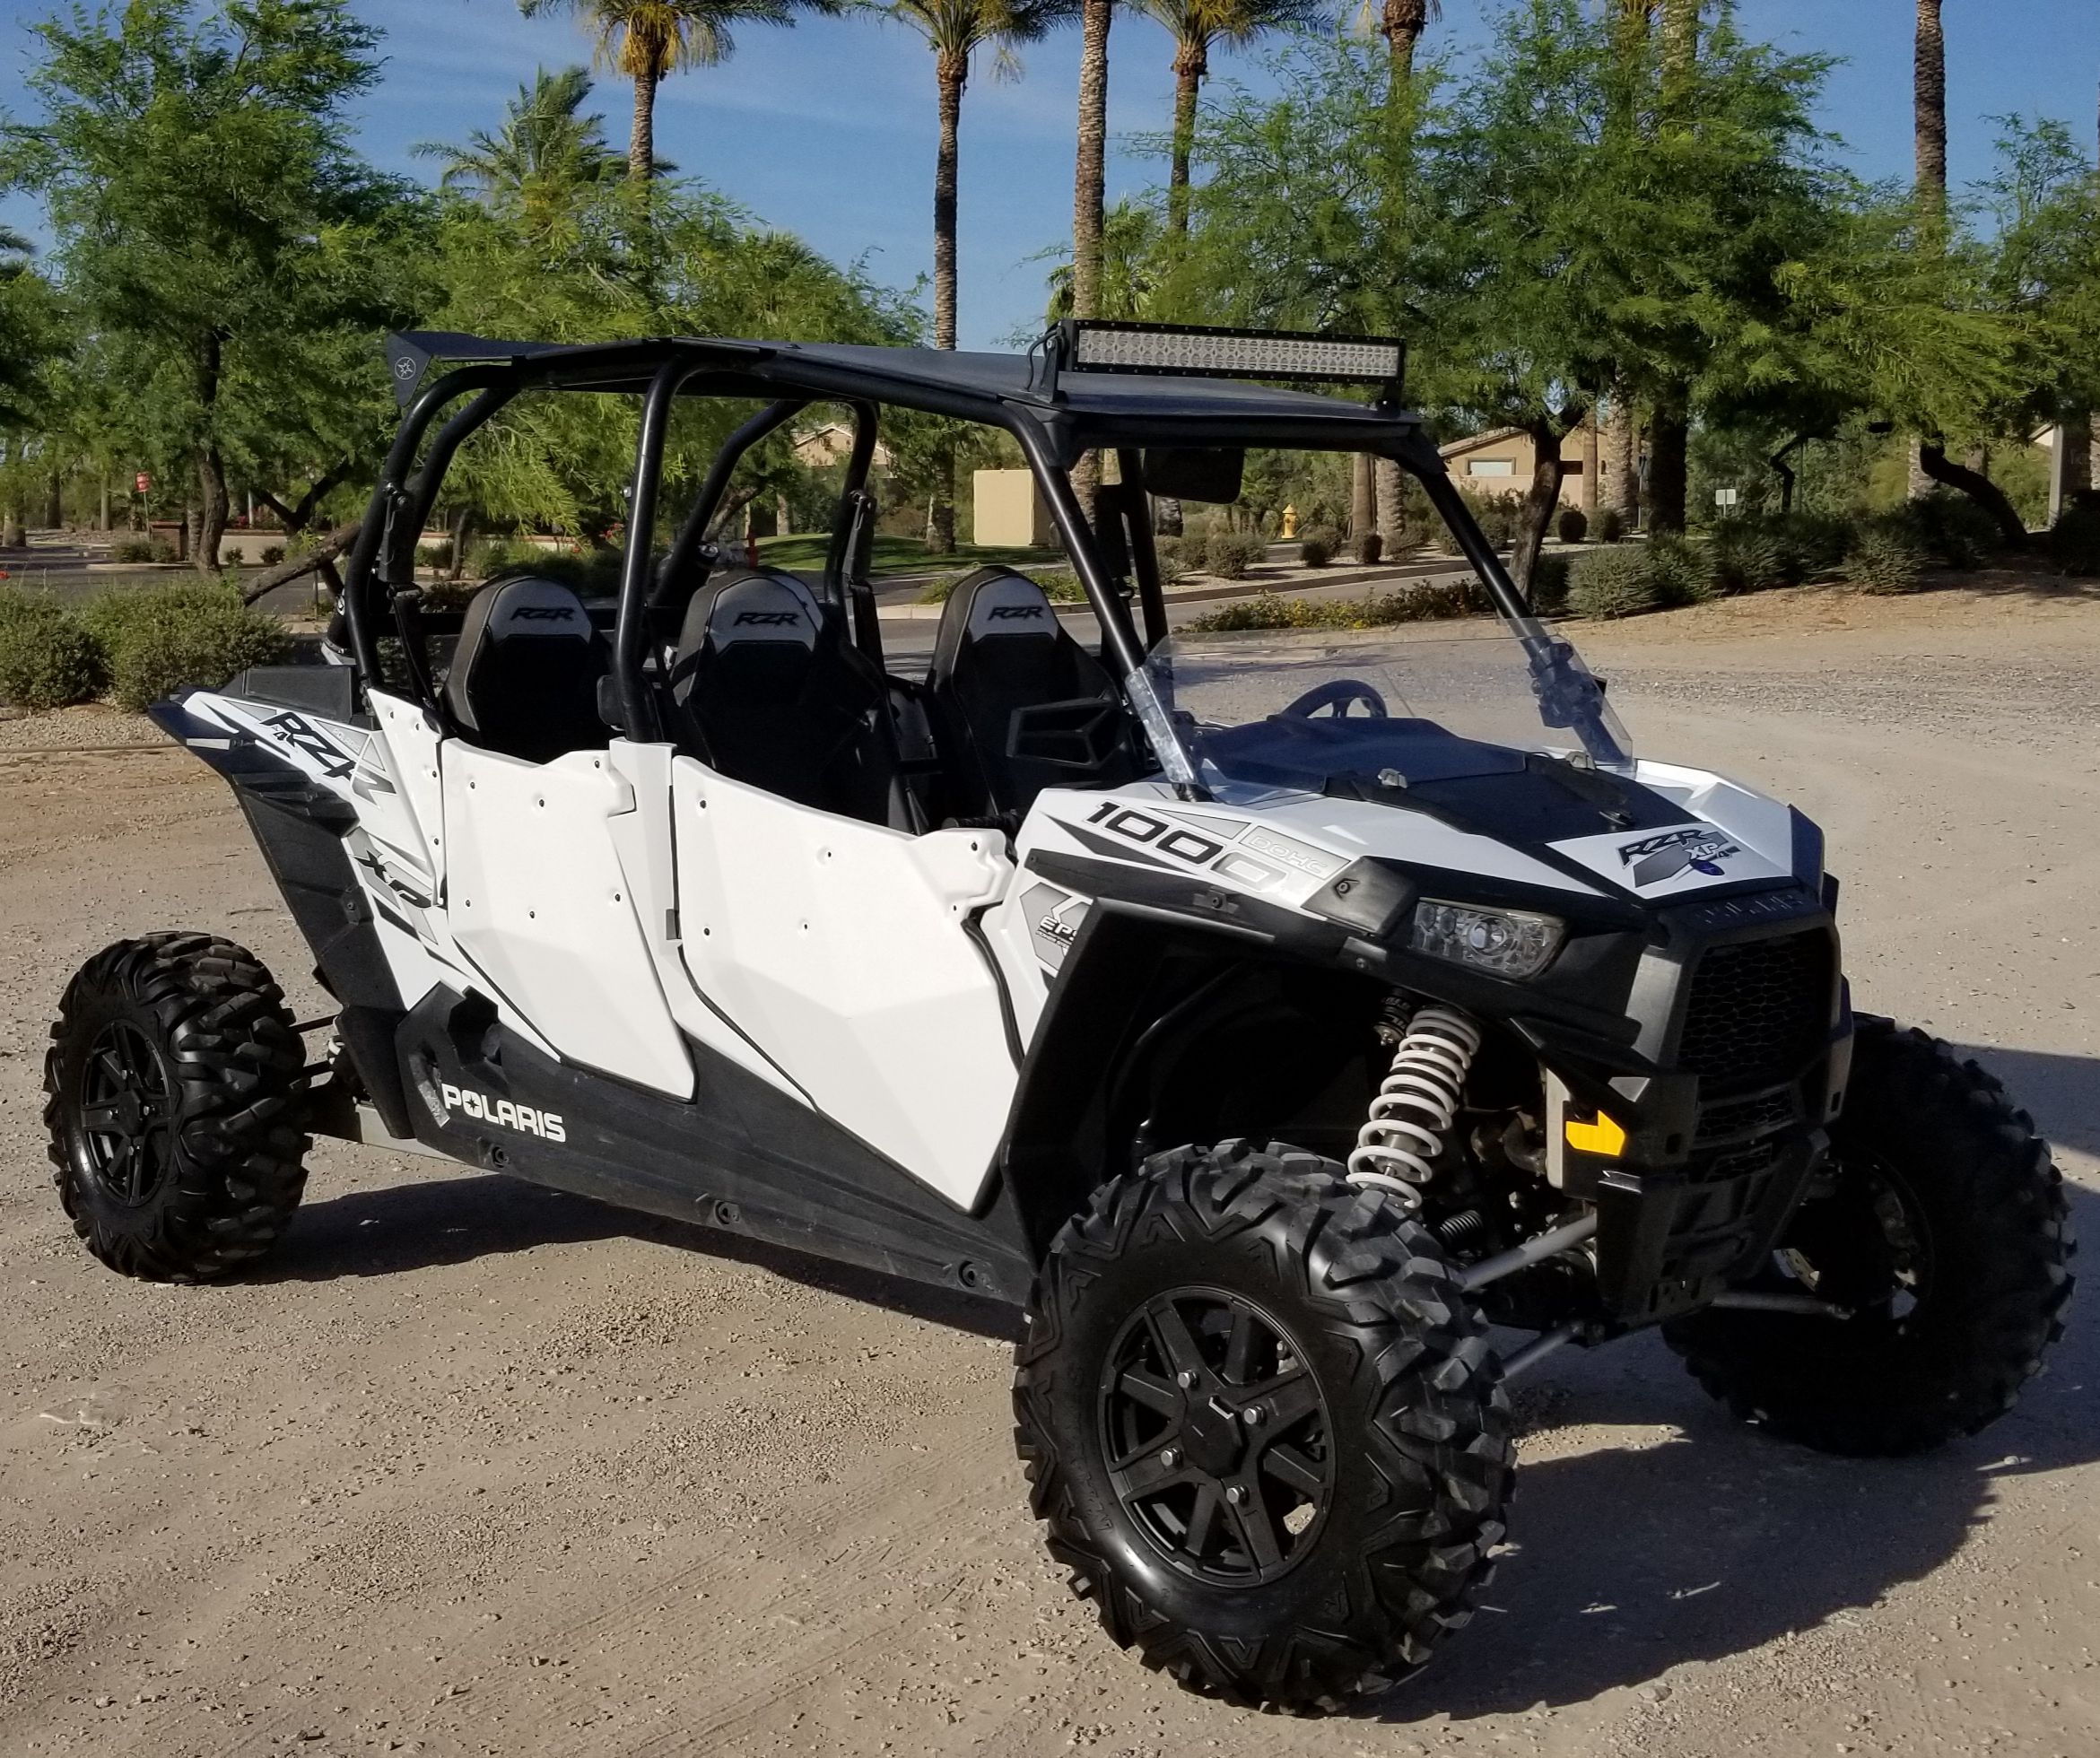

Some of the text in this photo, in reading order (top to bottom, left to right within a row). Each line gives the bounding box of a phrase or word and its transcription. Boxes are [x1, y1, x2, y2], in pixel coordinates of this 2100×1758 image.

[510, 606, 574, 622] RZR
[733, 612, 798, 627] RZR
[988, 605, 1042, 620] RZR
[1085, 801, 1292, 893] 1000
[1250, 834, 1328, 875] DOHC
[1617, 830, 1709, 867] RZR
[441, 1083, 566, 1143] POLARIS
